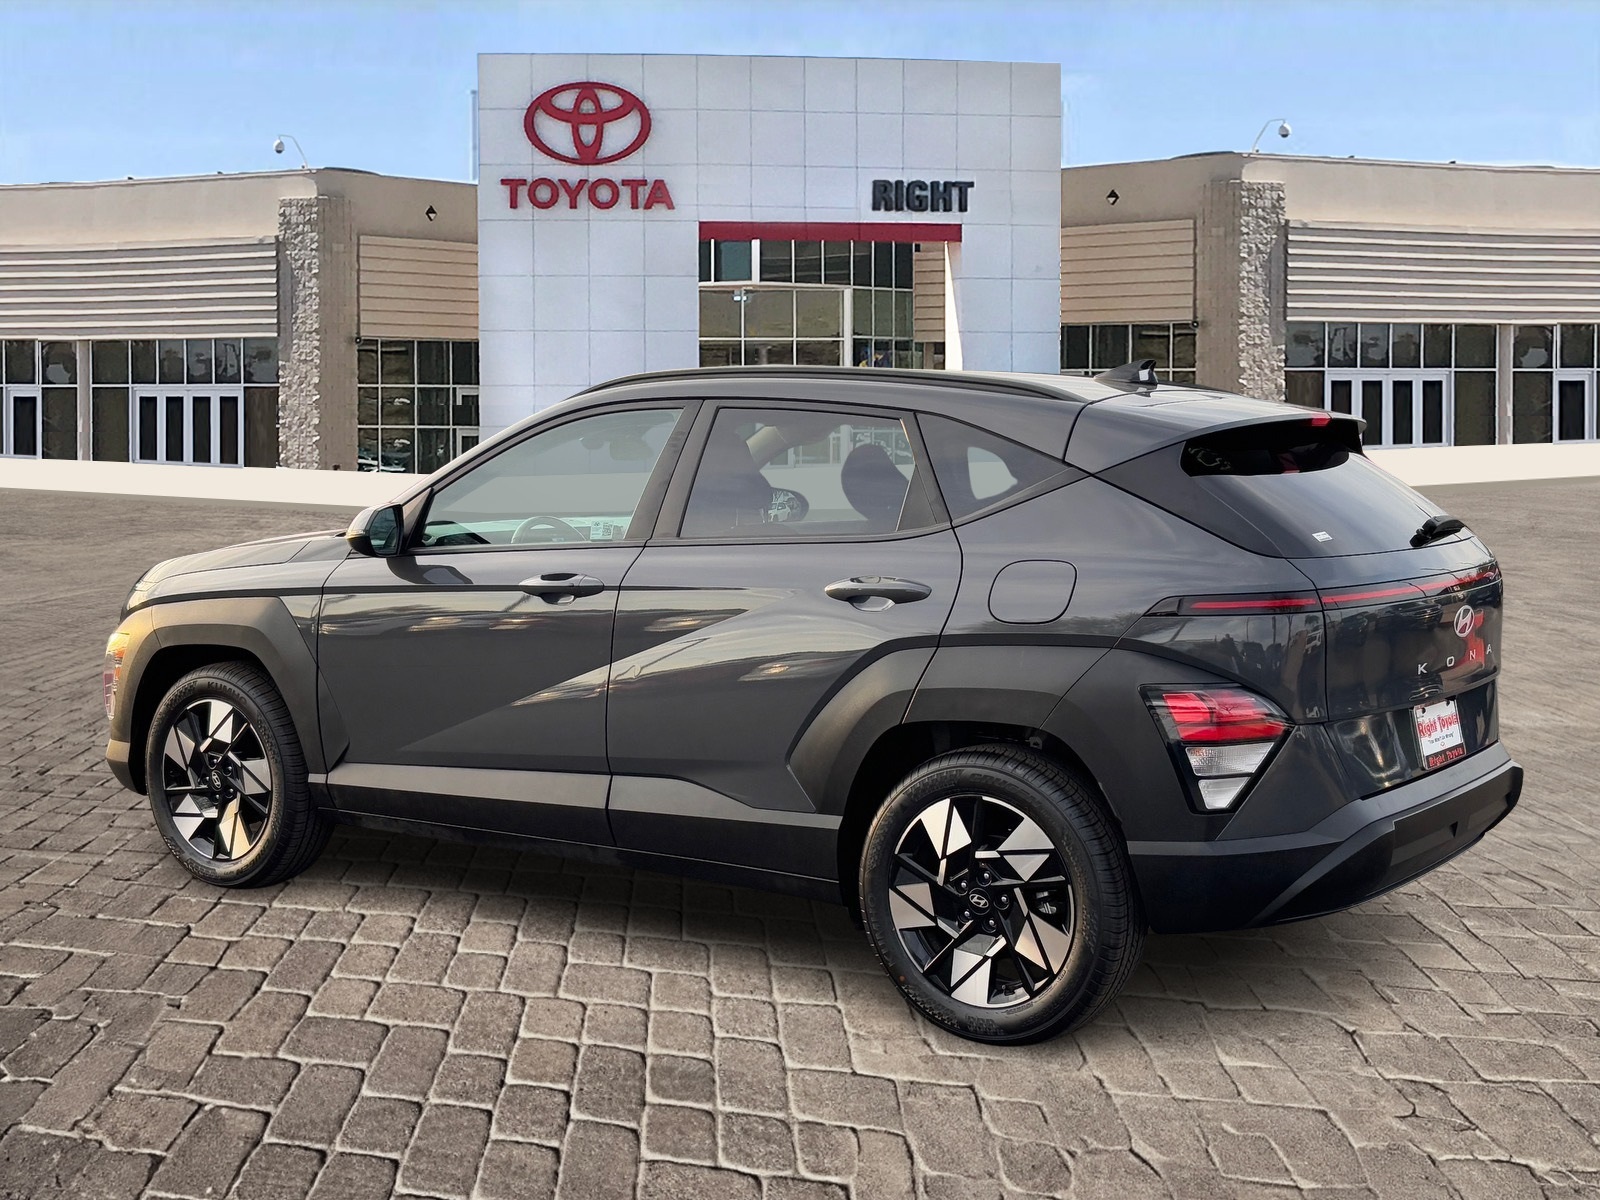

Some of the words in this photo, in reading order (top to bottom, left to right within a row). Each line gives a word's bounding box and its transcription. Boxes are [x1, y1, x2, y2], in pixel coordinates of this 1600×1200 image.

[500, 178, 675, 209] TOYOTA
[872, 179, 975, 212] RIGHT
[1418, 643, 1493, 675] KONA
[1417, 718, 1438, 738] Right
